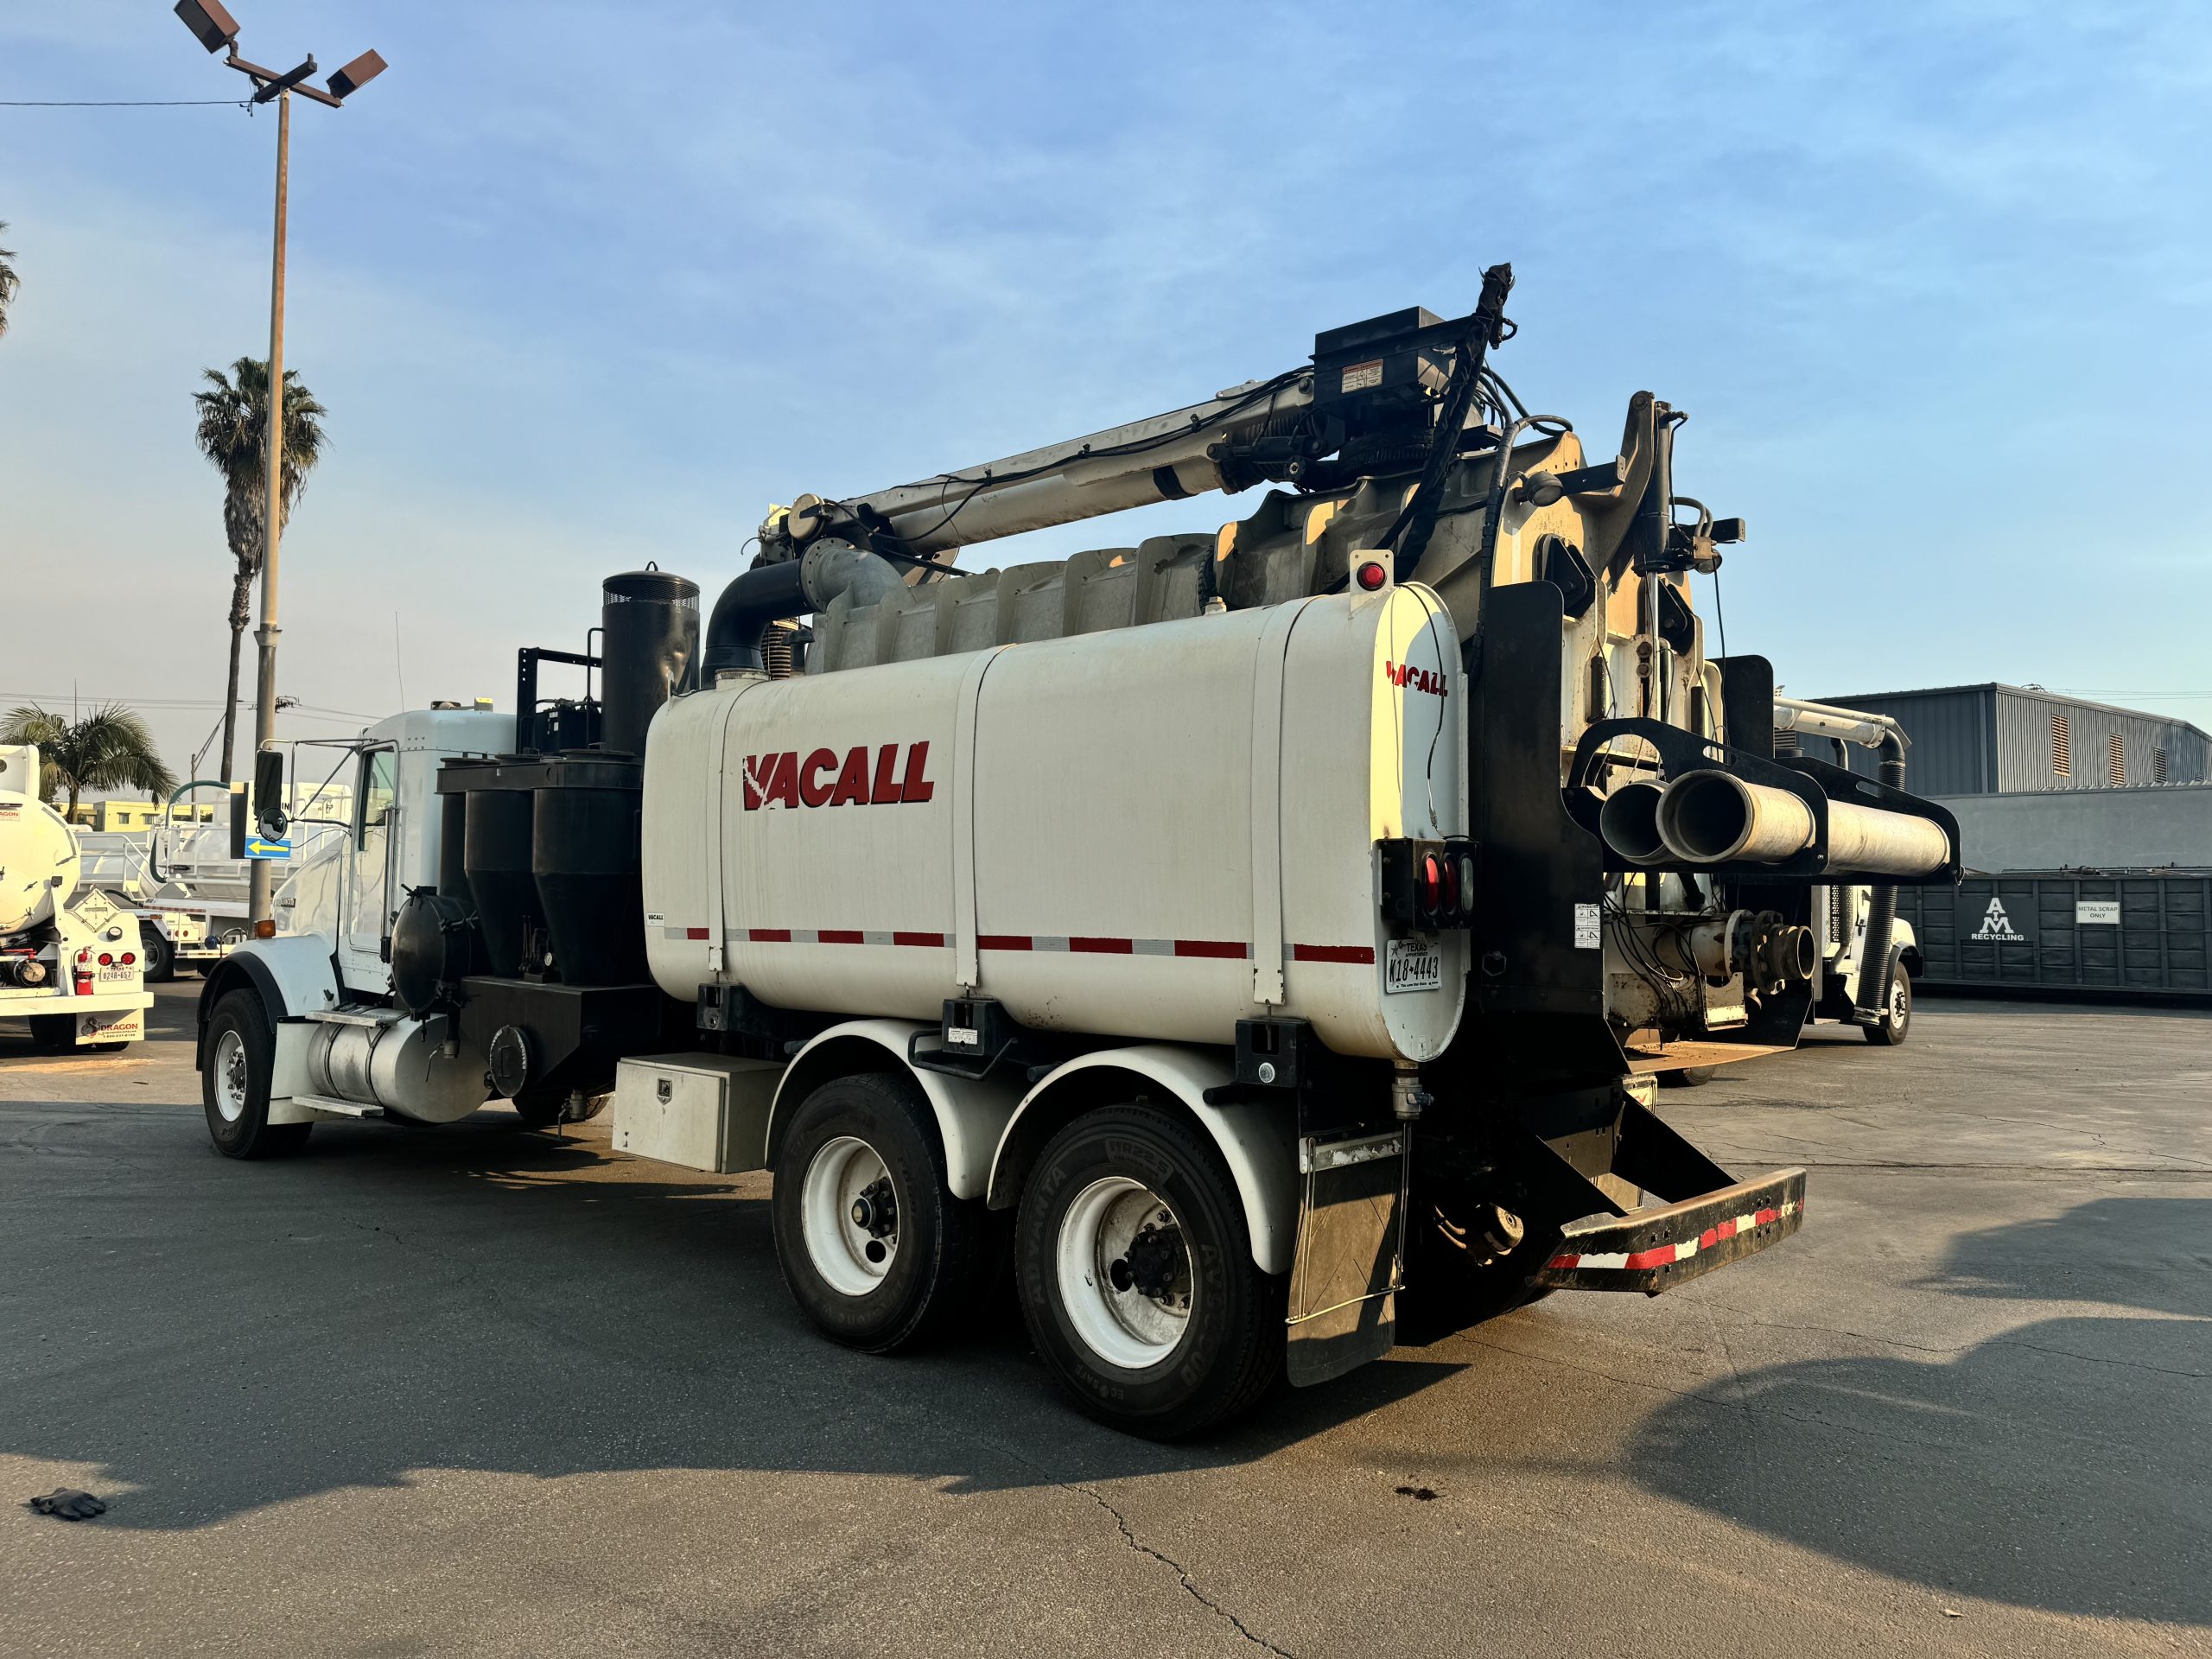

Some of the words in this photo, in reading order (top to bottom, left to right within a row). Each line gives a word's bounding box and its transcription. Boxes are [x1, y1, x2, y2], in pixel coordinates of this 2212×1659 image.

[1386, 661, 1448, 696] VACALL
[742, 741, 935, 810] VACALL
[1406, 942, 1427, 952] TEXAS
[1027, 1166, 1065, 1304] ADVANTA
